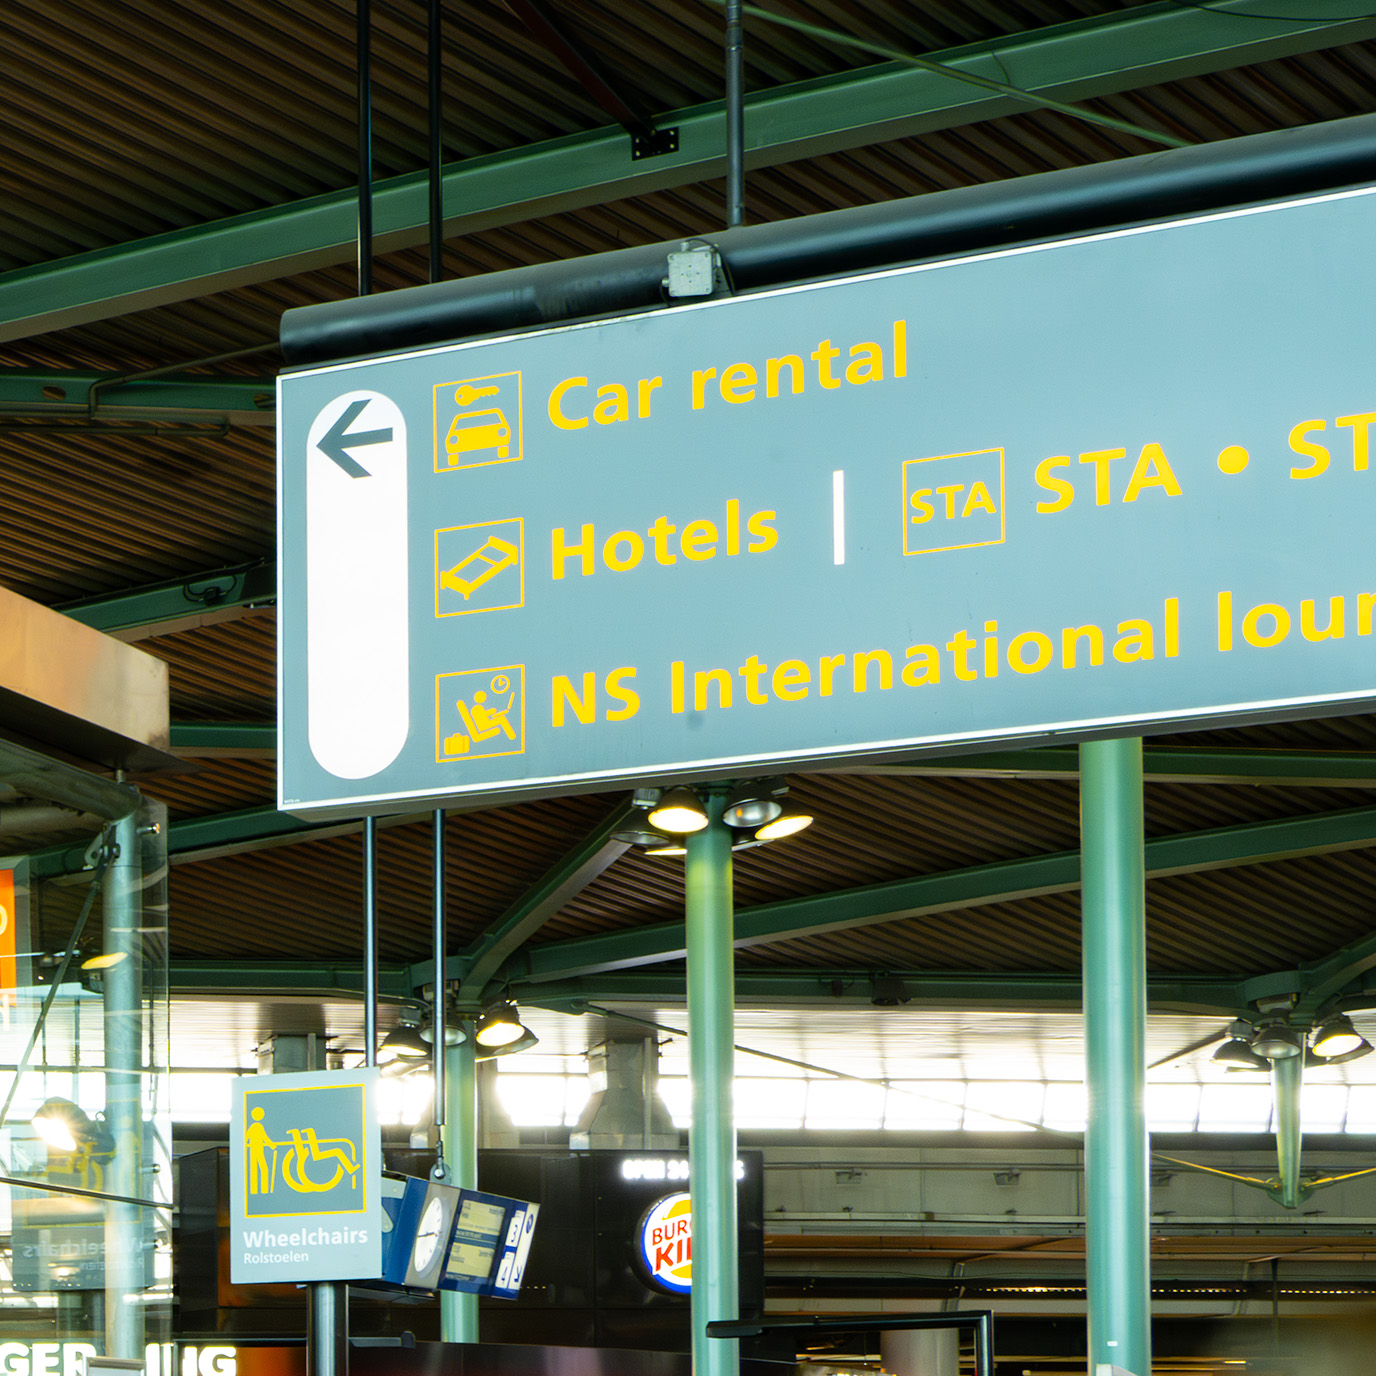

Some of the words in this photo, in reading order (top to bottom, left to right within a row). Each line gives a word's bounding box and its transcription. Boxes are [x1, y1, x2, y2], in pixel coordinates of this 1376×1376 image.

[548, 374, 661, 432] Car
[691, 319, 908, 411] rental
[909, 481, 997, 525] STA
[1034, 442, 1182, 515] STA
[551, 498, 779, 582] Hotels
[551, 668, 640, 729] NS
[671, 596, 1180, 714] International
[243, 1226, 368, 1249] Wheelchairs
[243, 1250, 309, 1265] Rolstoelen
[652, 1219, 692, 1246] BUR
